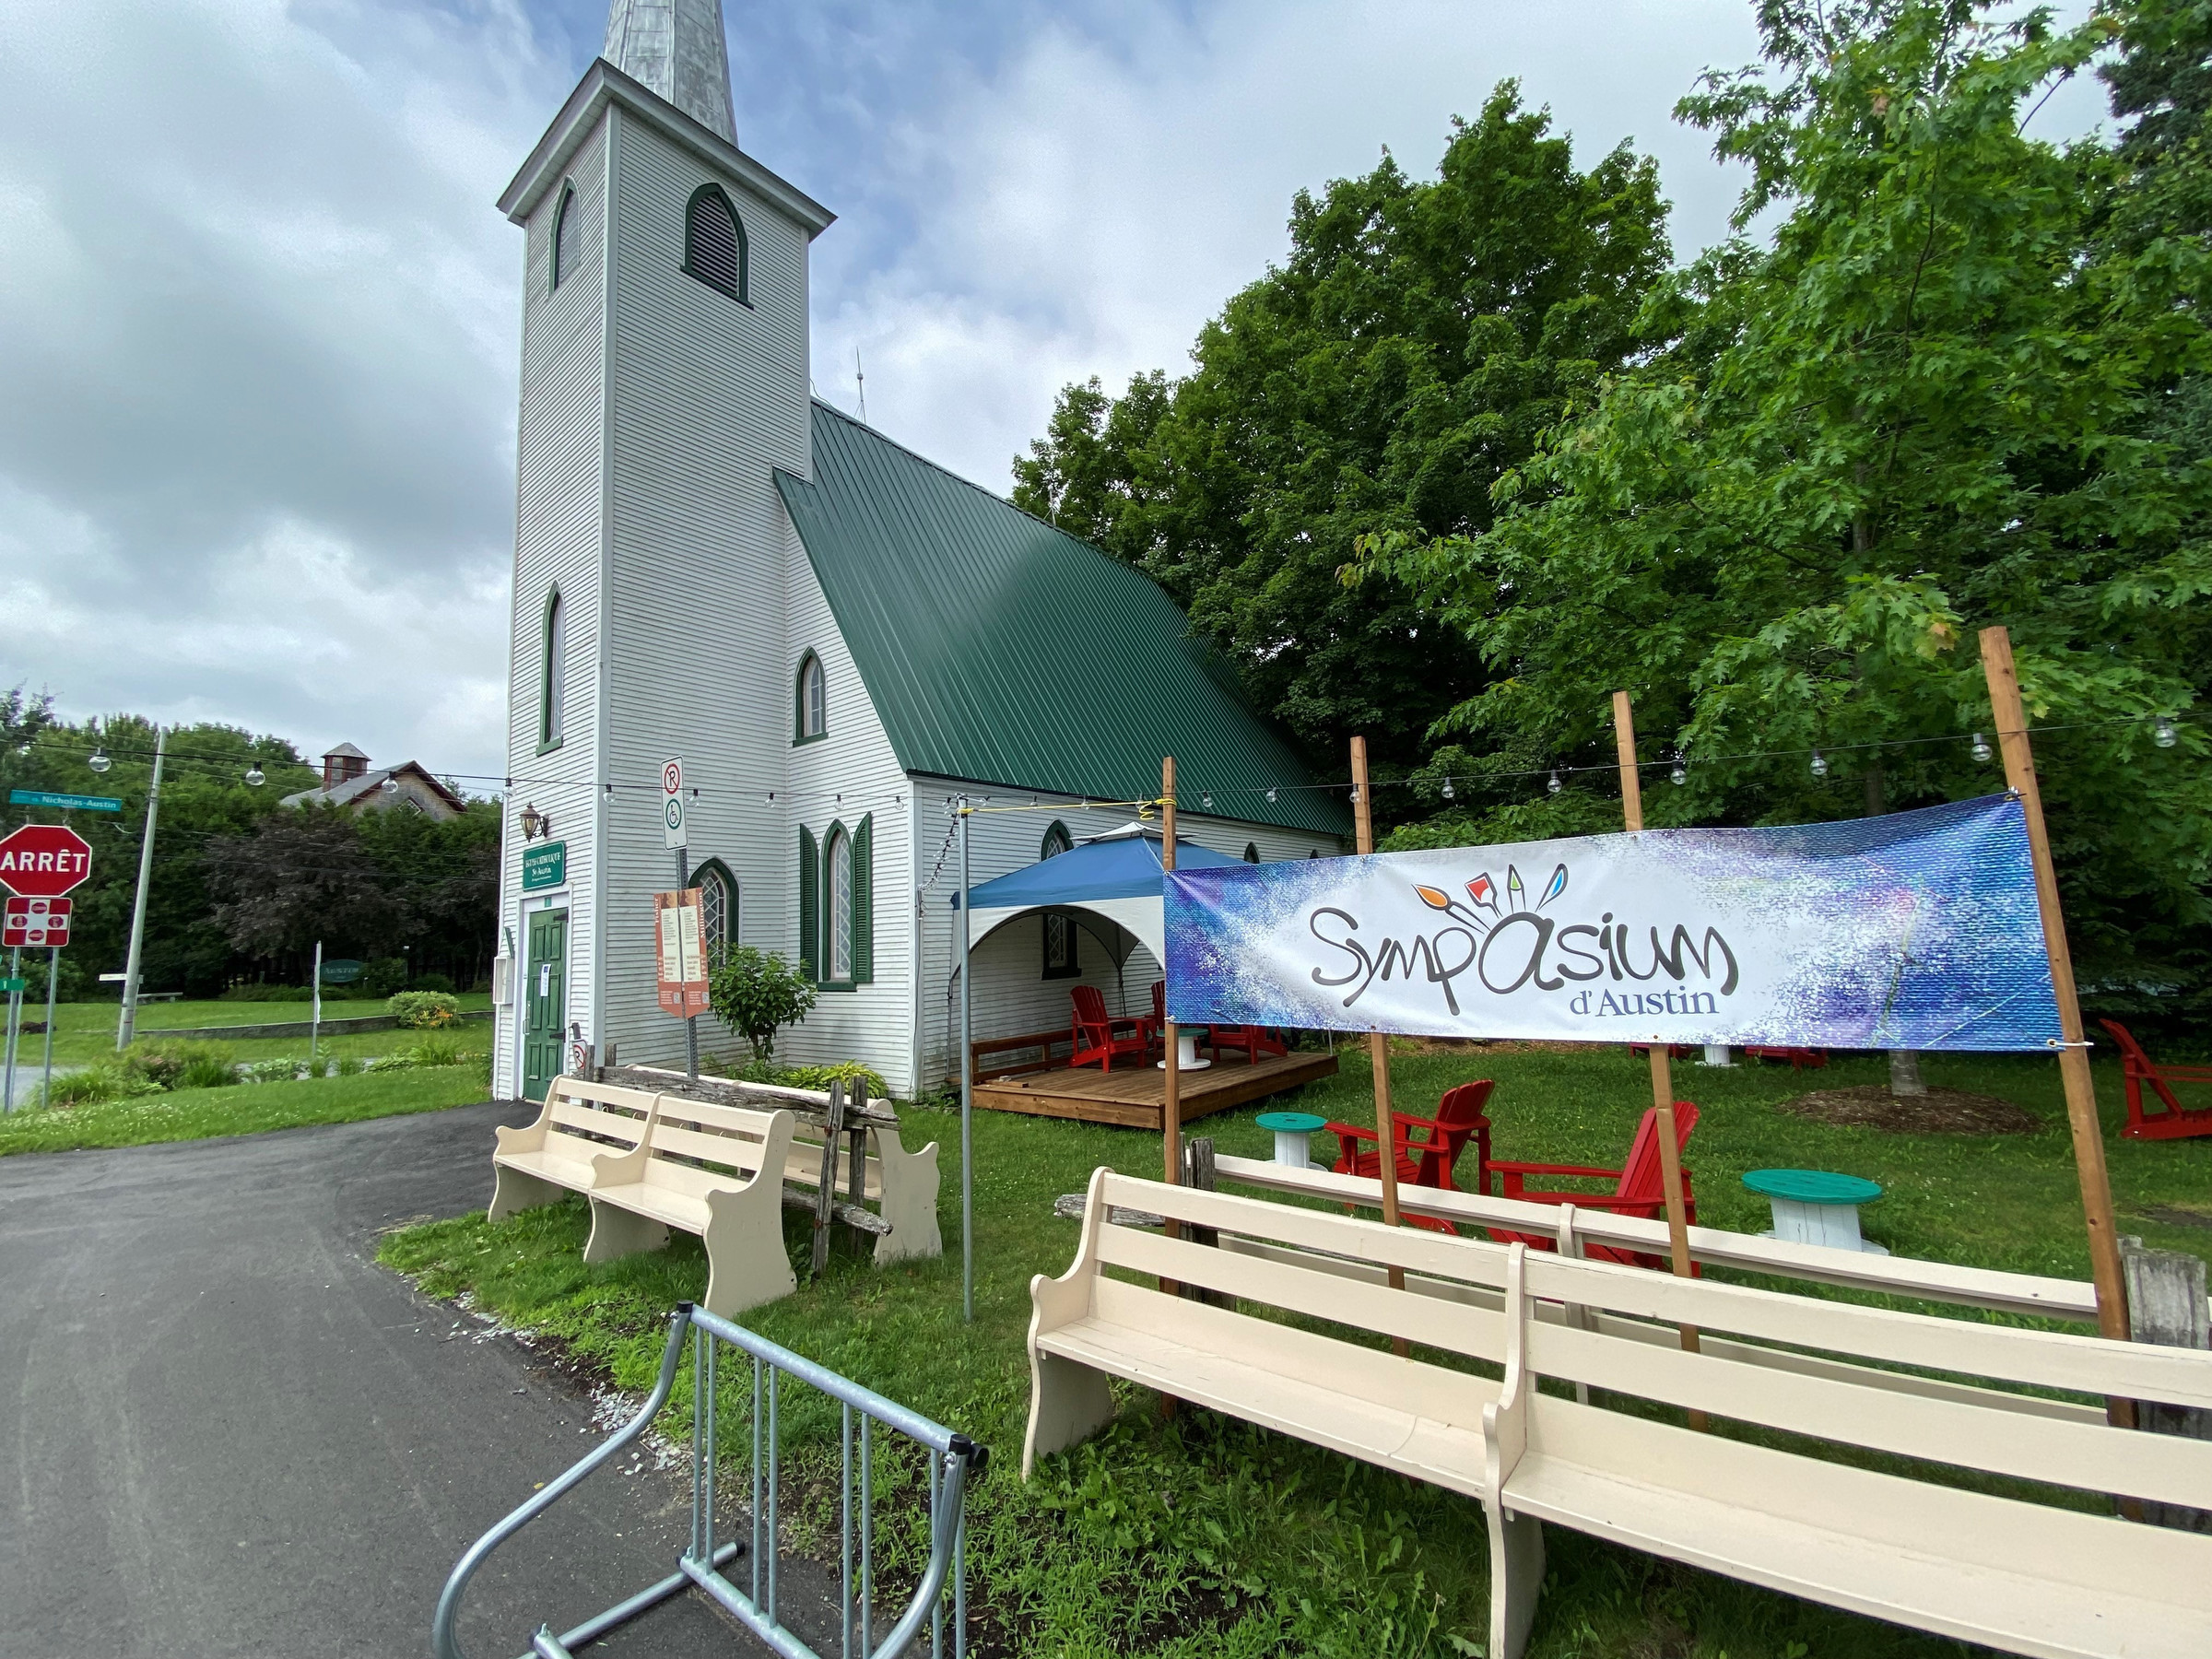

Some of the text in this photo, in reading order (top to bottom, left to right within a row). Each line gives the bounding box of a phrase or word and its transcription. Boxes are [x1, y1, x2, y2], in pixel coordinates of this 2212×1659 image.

[41, 795, 117, 808] Nicholas-Austin
[0, 849, 87, 873] ARRÊT
[1571, 985, 1721, 1017] d'Austin
